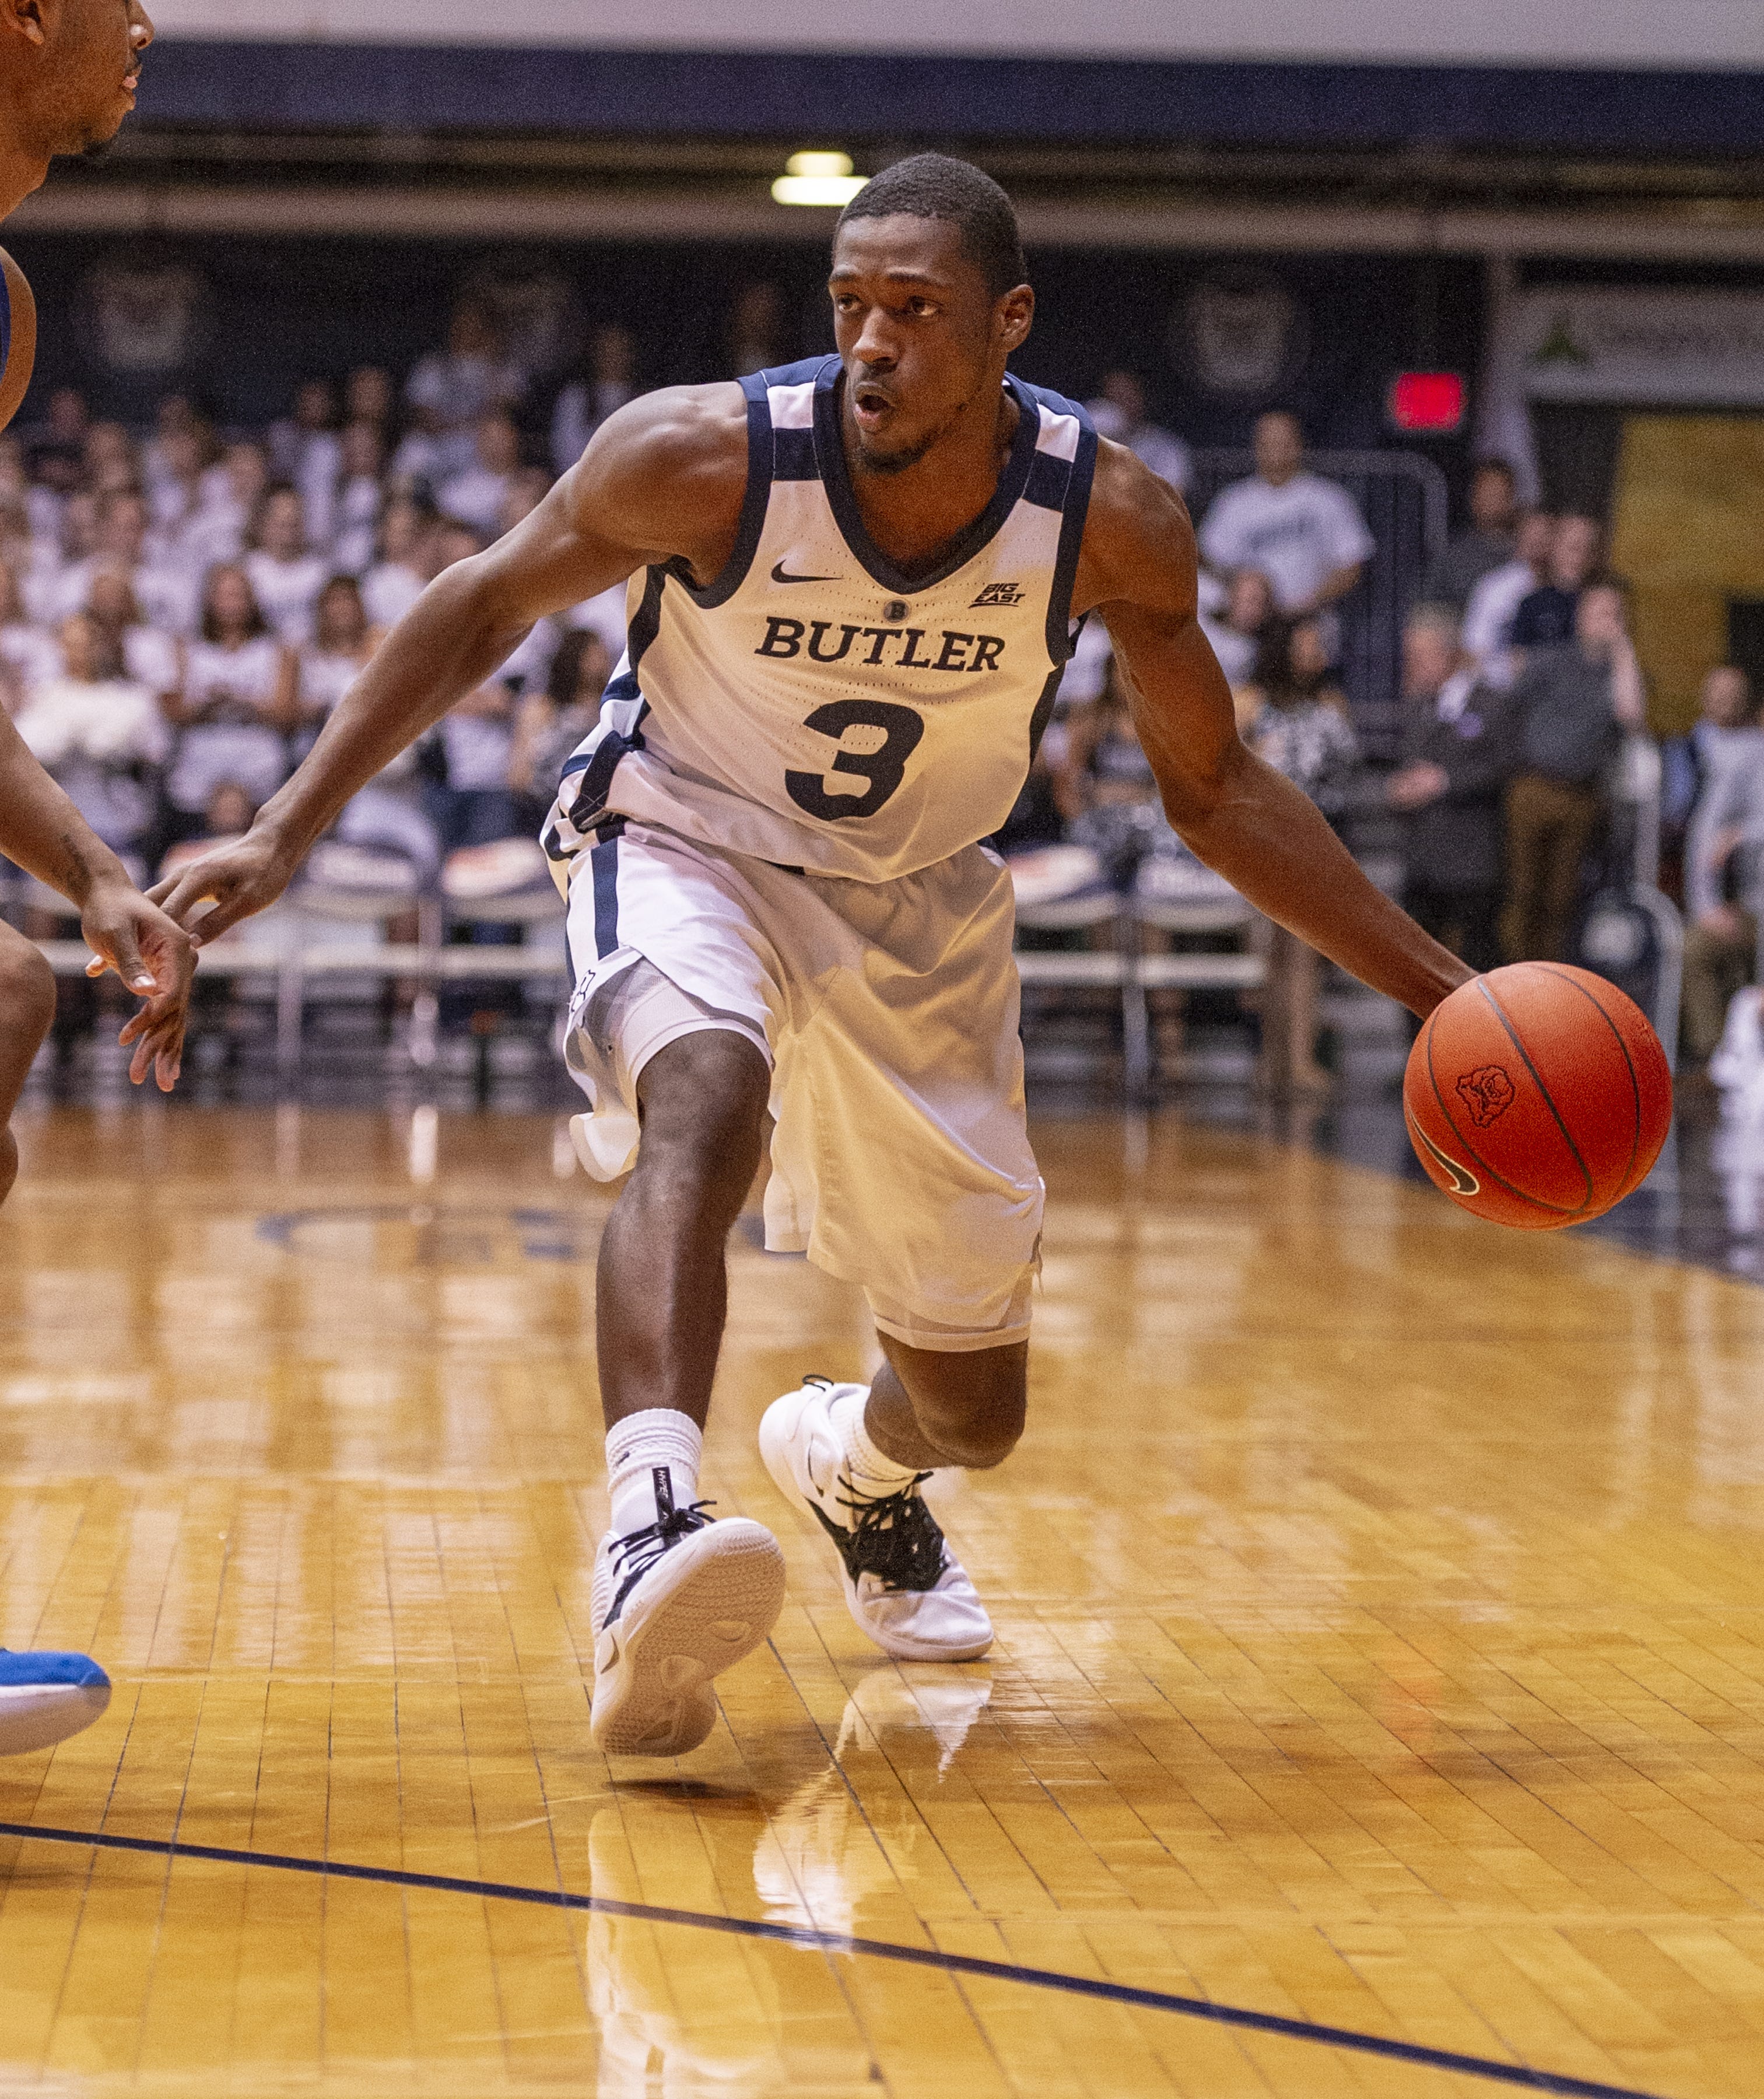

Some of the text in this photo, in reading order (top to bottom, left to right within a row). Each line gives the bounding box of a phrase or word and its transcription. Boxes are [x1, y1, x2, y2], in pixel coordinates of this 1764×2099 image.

[974, 593, 1026, 603] EAST
[982, 582, 1019, 594] BIG
[755, 616, 1005, 672] BUTLER
[785, 699, 925, 821] 3
